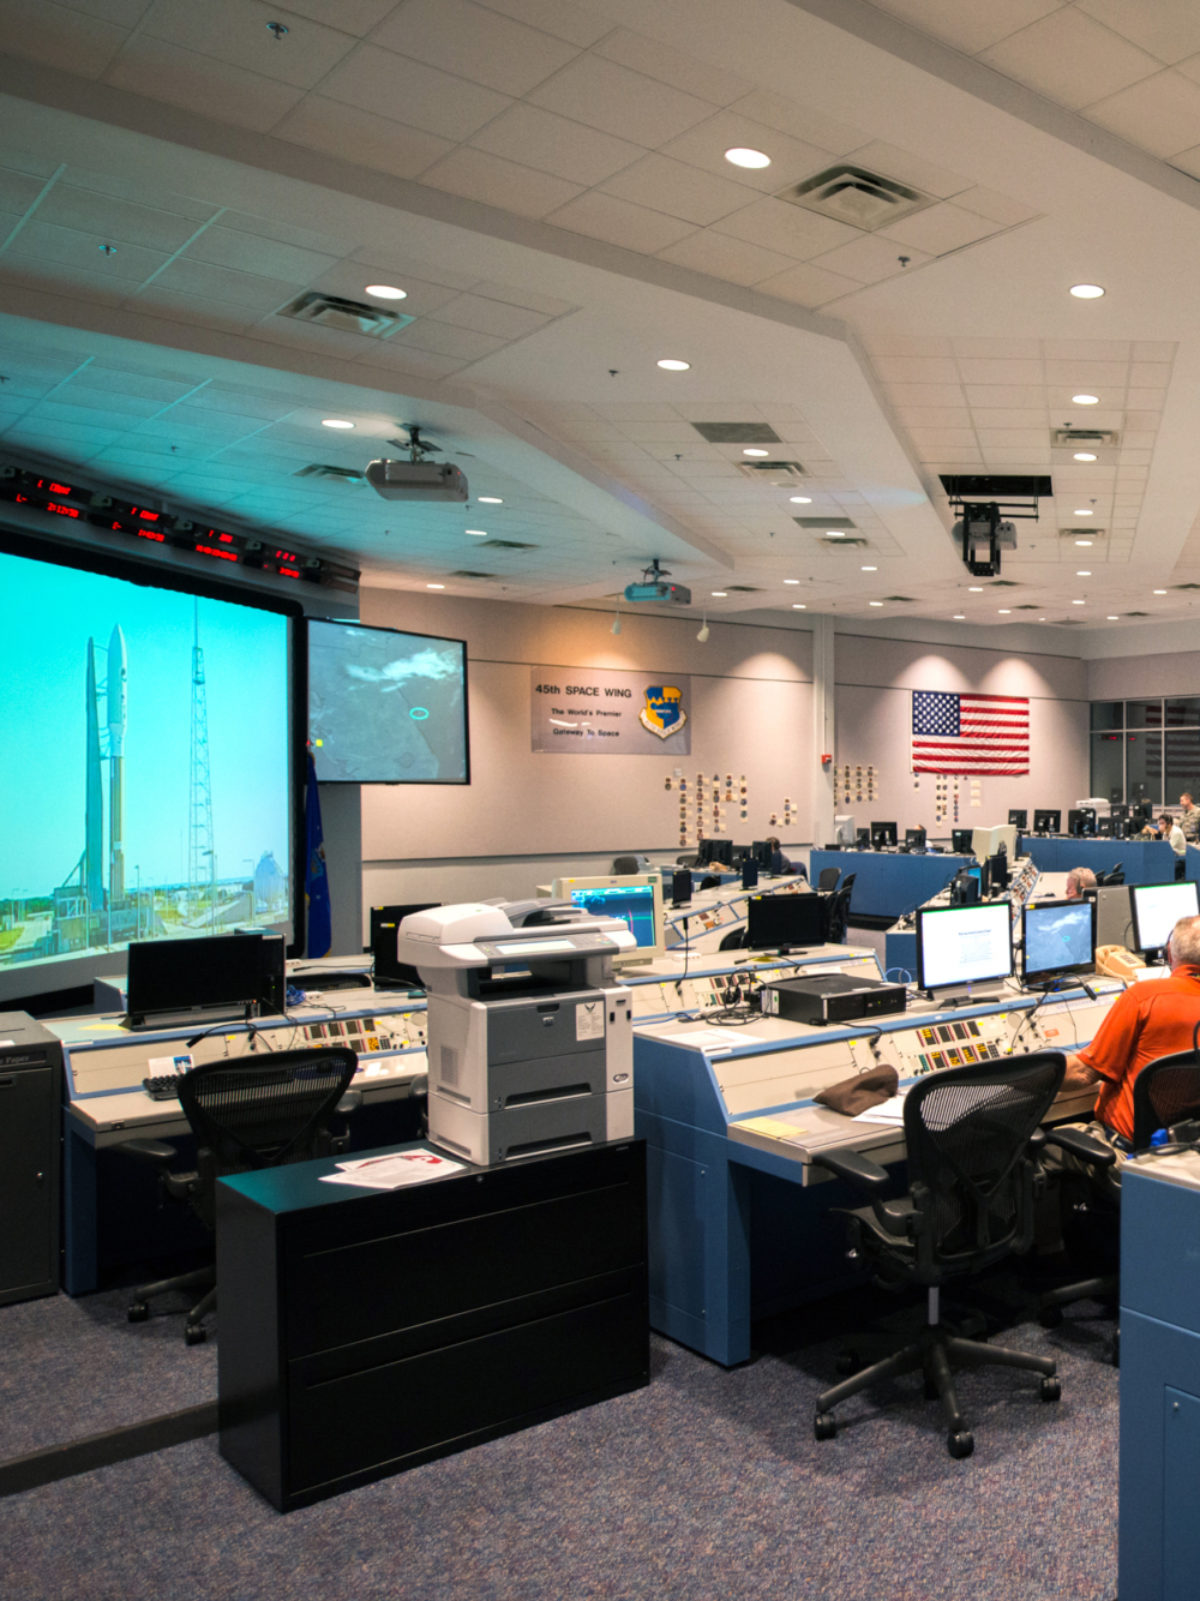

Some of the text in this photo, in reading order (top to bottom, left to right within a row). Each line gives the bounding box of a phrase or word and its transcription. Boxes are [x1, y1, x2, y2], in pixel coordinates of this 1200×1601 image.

[535, 684, 632, 698] 45th SPACE WING
[553, 728, 583, 737] Gateway
[598, 729, 620, 737] Space
